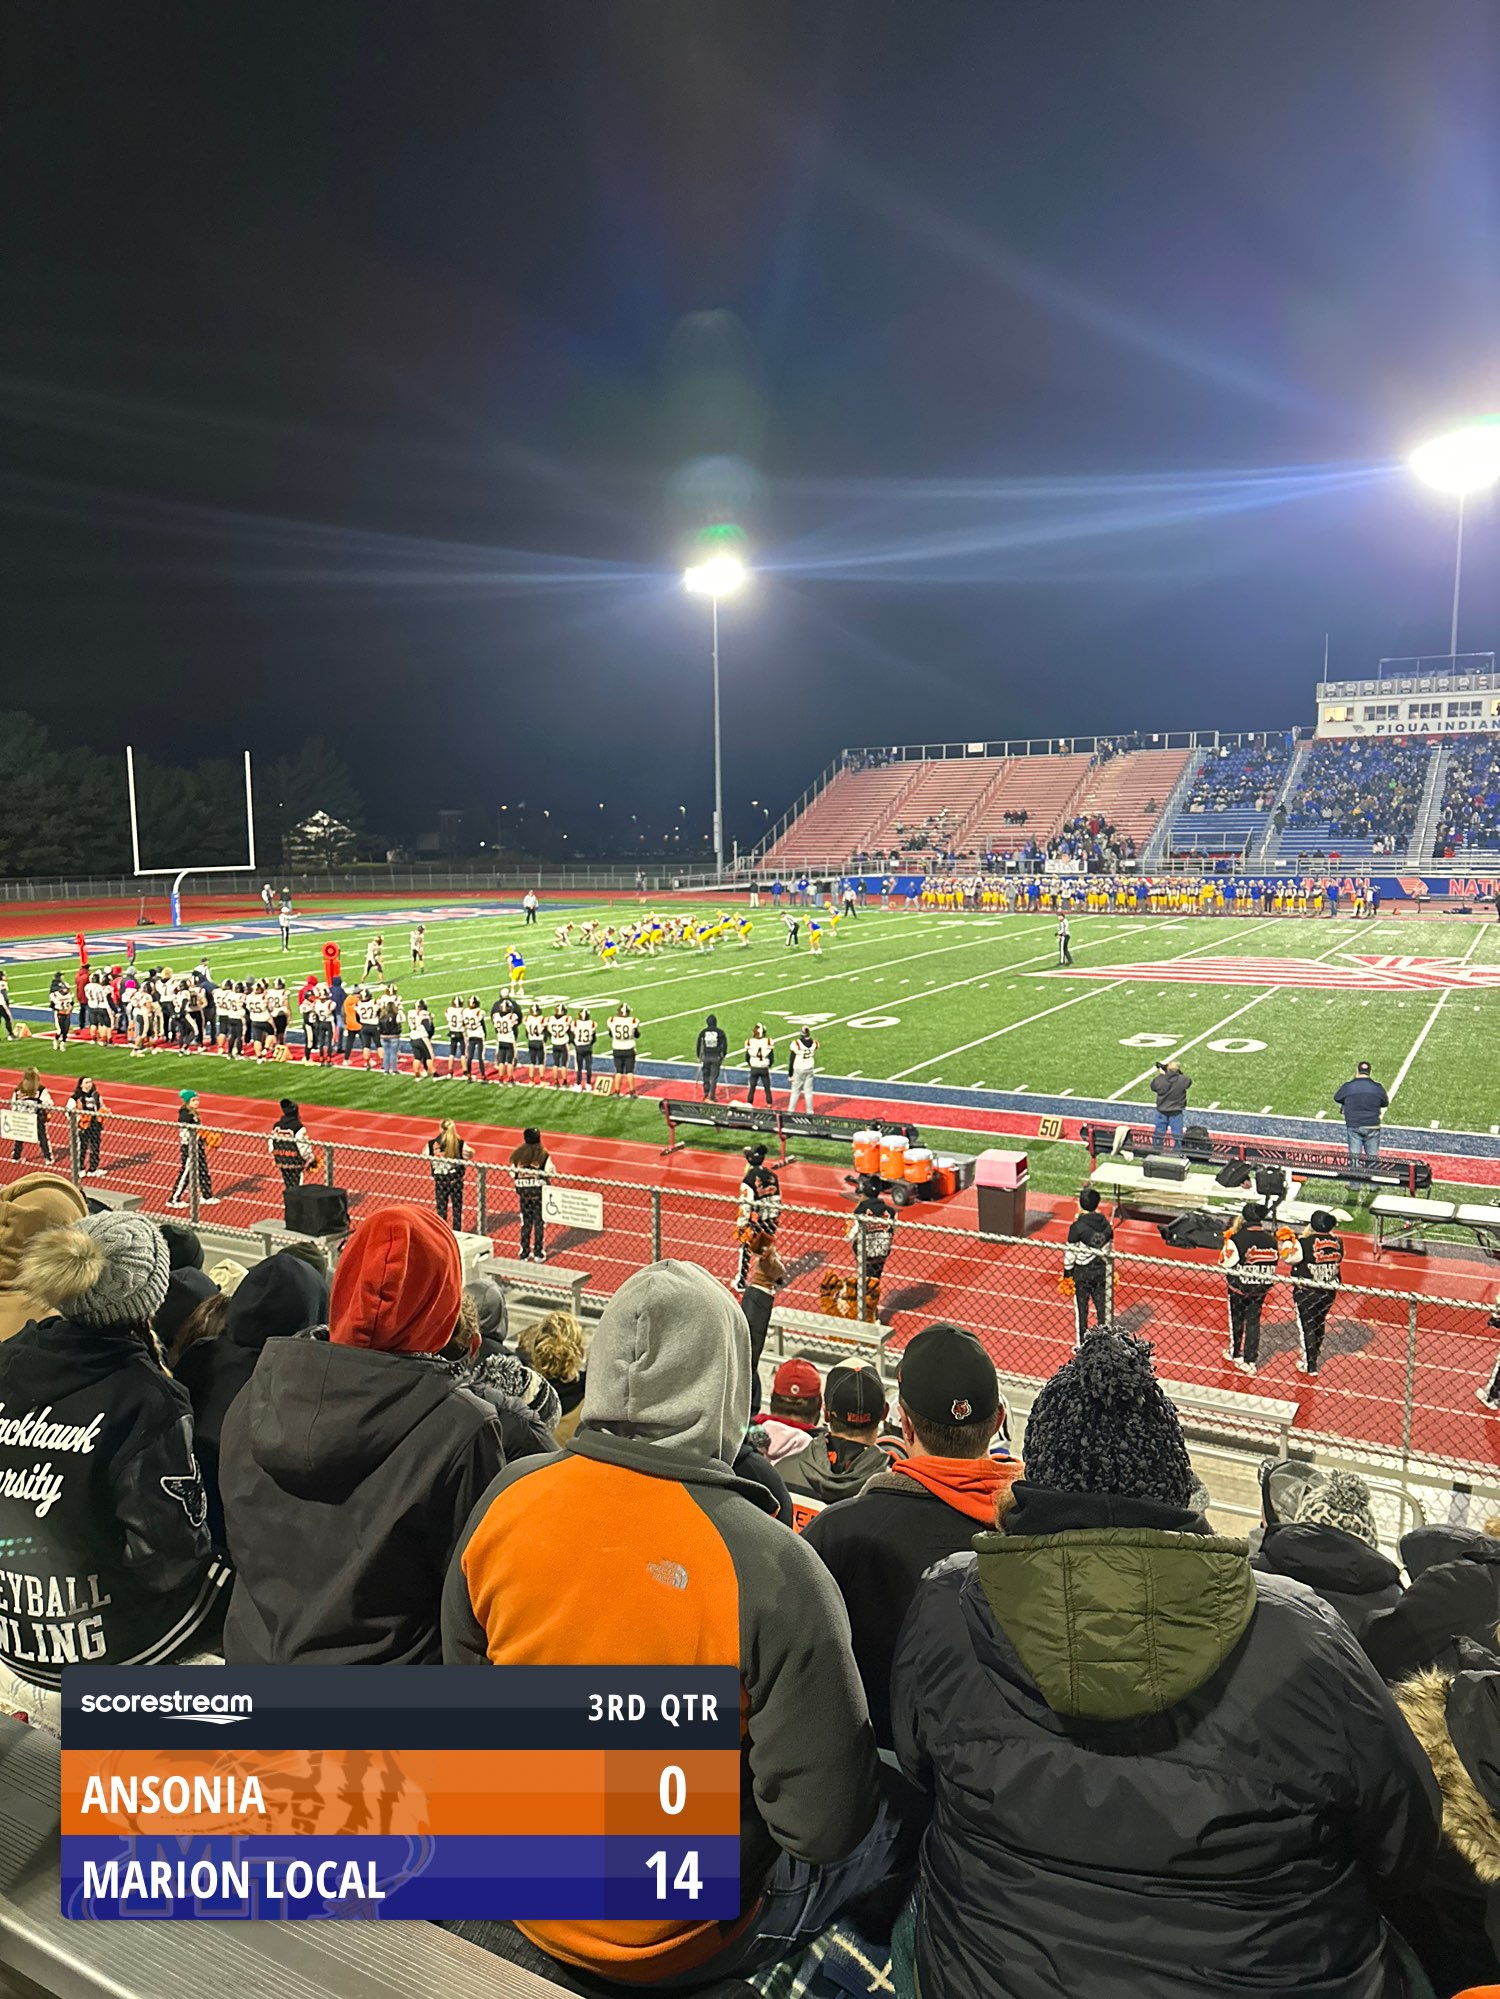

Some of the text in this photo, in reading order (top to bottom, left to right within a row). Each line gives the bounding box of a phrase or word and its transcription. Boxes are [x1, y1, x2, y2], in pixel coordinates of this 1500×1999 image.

[1377, 723, 1430, 734] PIQUA
[1449, 879, 1500, 896] NATI
[615, 1024, 629, 1040] 58
[756, 1048, 763, 1062] 4
[596, 1079, 610, 1094] 40
[1041, 1119, 1060, 1137] 50
